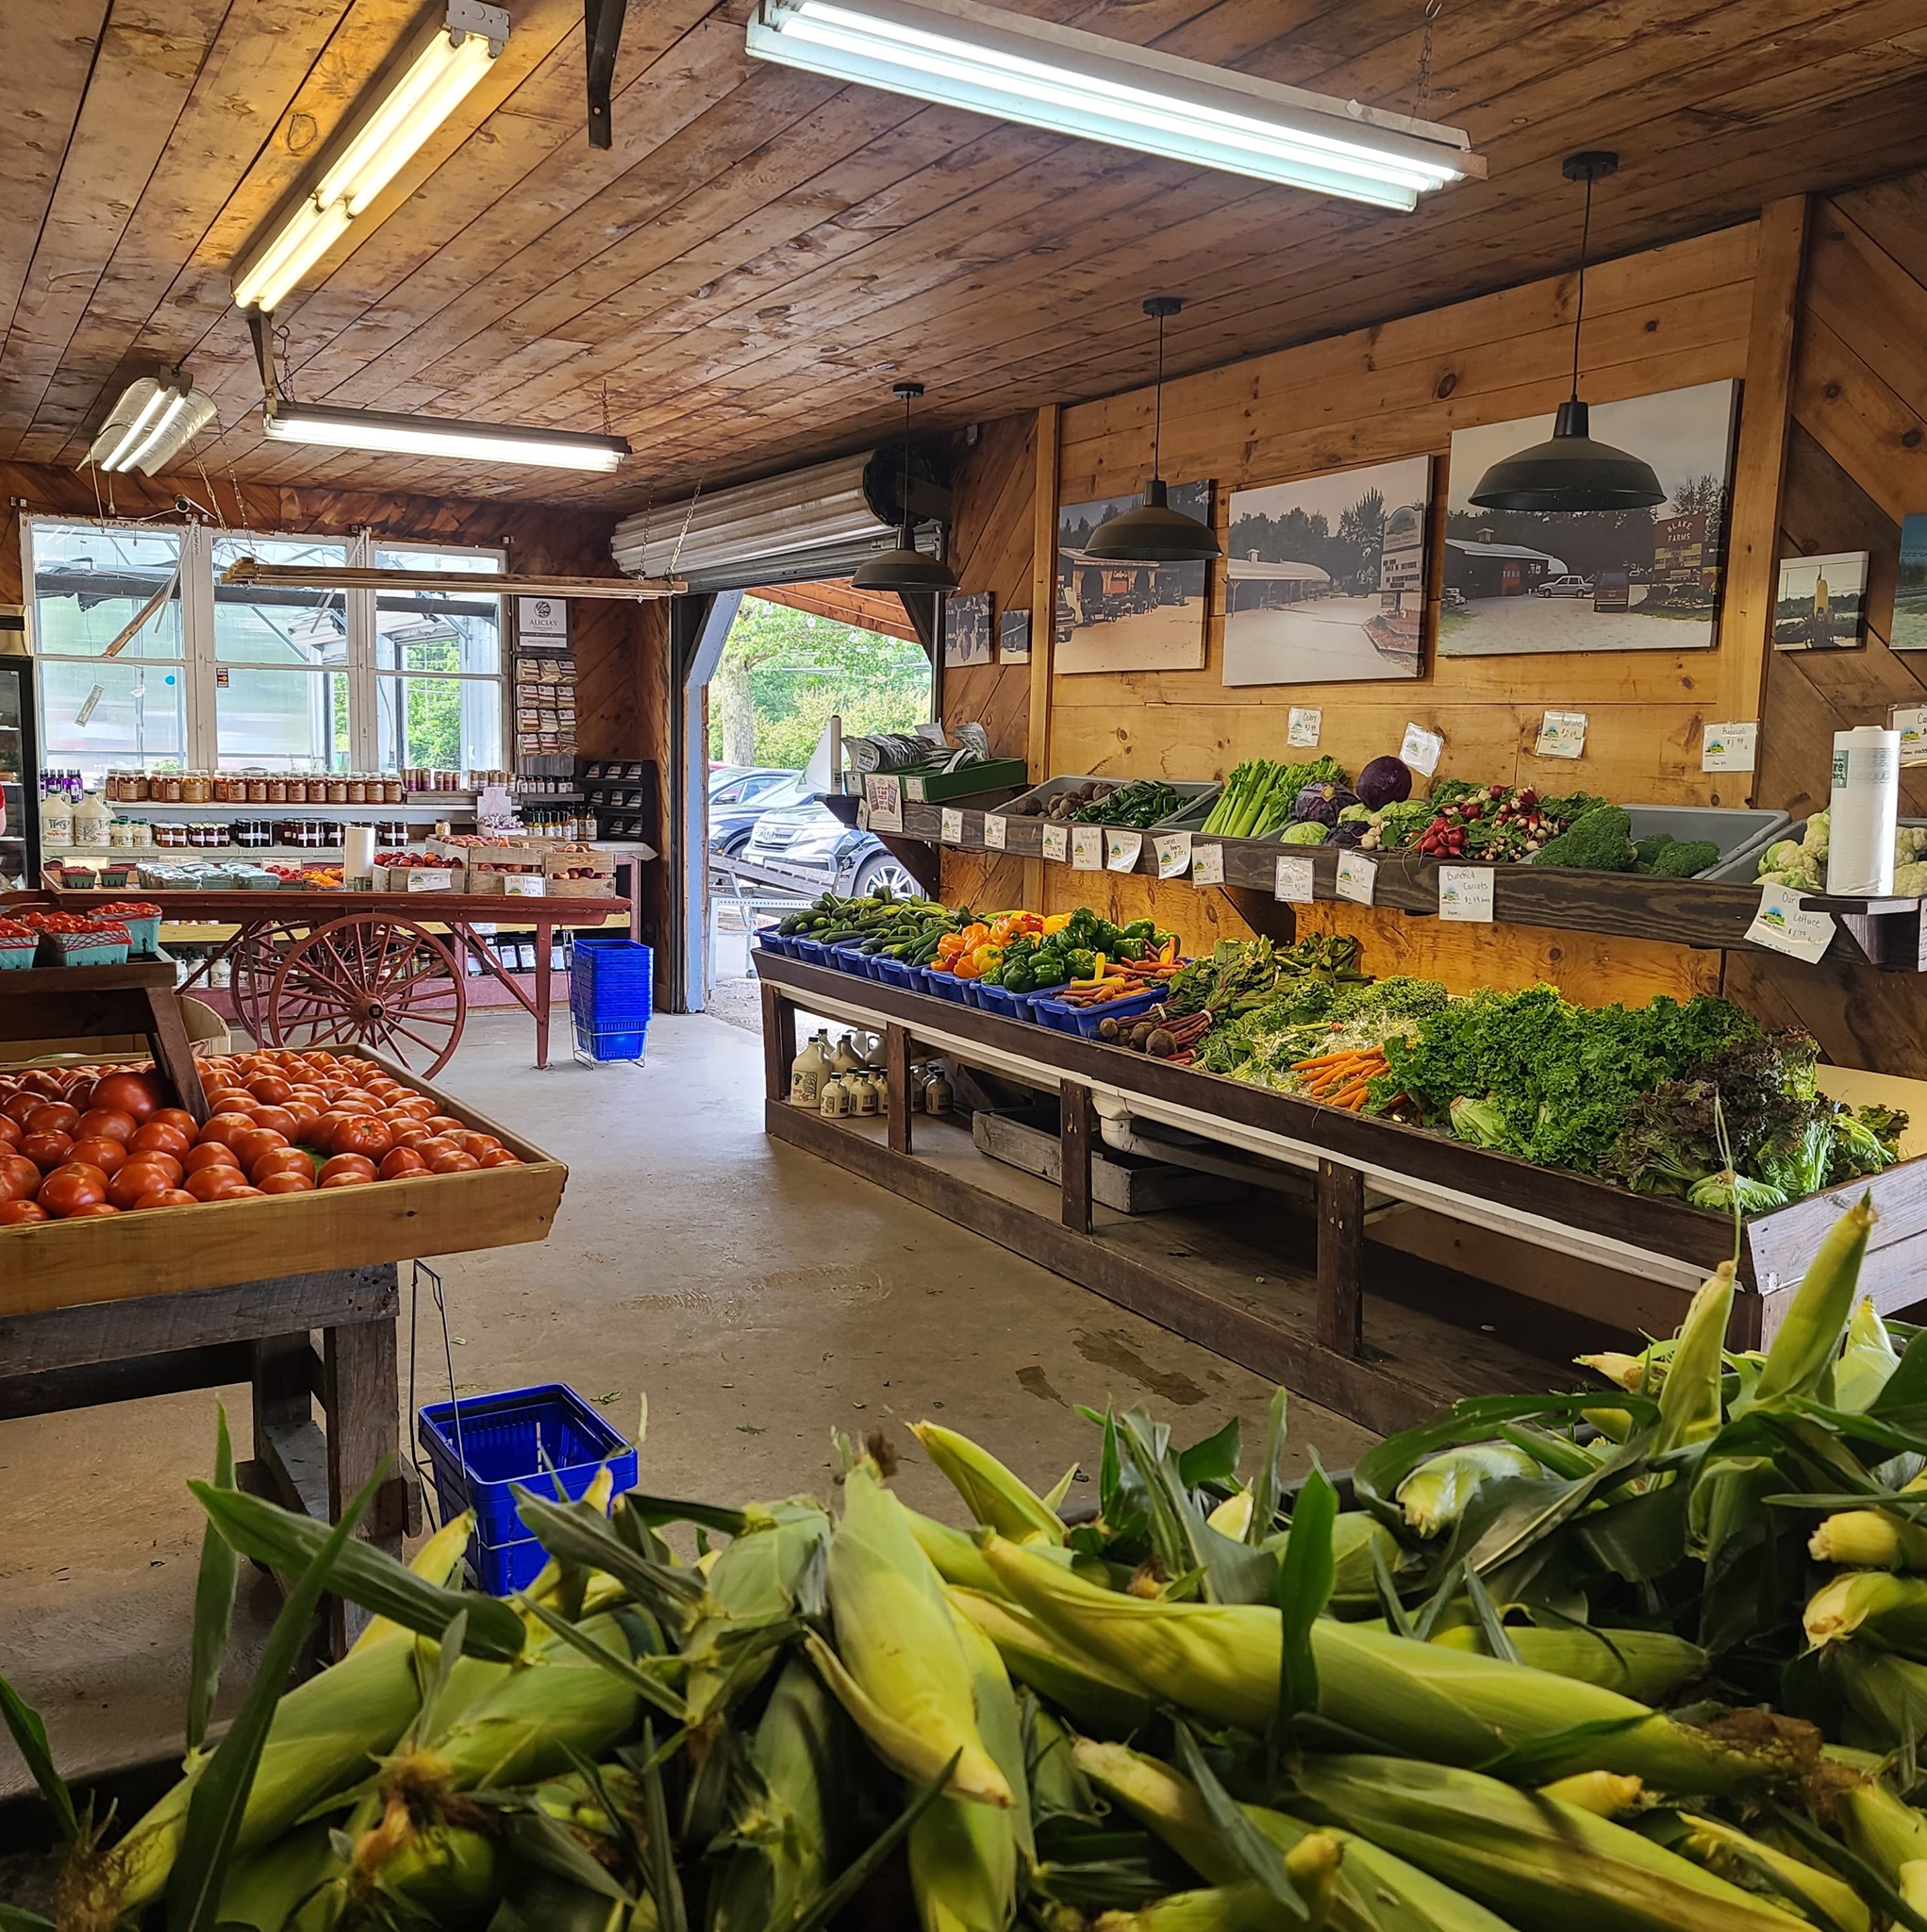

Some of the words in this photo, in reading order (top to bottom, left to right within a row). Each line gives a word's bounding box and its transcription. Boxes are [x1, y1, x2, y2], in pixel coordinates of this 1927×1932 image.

[1667, 520, 1693, 533] BLAKE
[1668, 533, 1691, 542] FARMS
[1463, 882, 1488, 891] Carrots
[1782, 891, 1796, 904] Our
[1793, 913, 1821, 928] Lettuce
